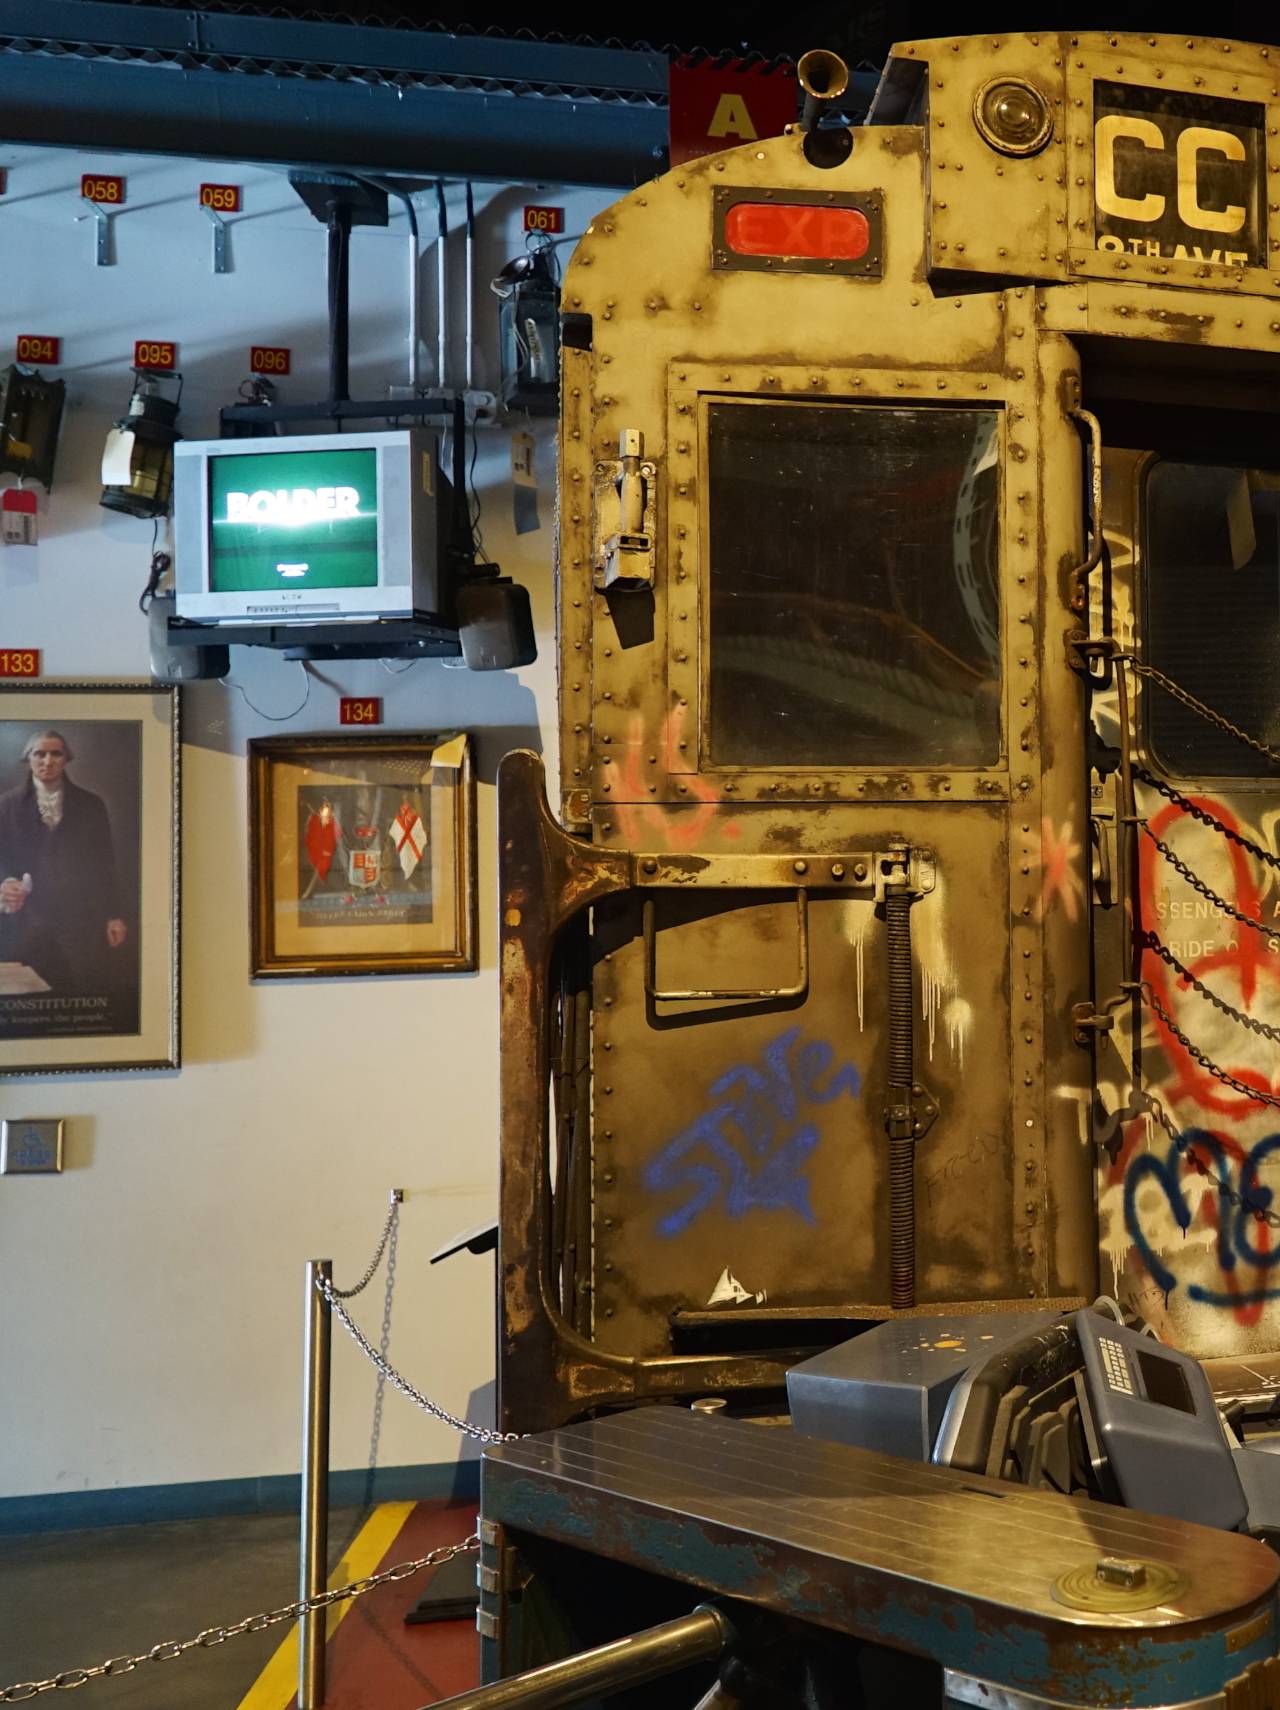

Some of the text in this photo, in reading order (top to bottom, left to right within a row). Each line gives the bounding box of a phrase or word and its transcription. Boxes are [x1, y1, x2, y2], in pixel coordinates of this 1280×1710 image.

[707, 93, 759, 140] A
[1094, 114, 1247, 233] CC
[83, 180, 118, 201] 058
[202, 188, 236, 208] 059
[527, 209, 556, 229] 061
[737, 207, 860, 253] EXP
[18, 338, 53, 359] 094
[138, 343, 173, 364] 095
[253, 348, 287, 370] 096
[1, 653, 34, 672] 133
[344, 702, 374, 721] 134
